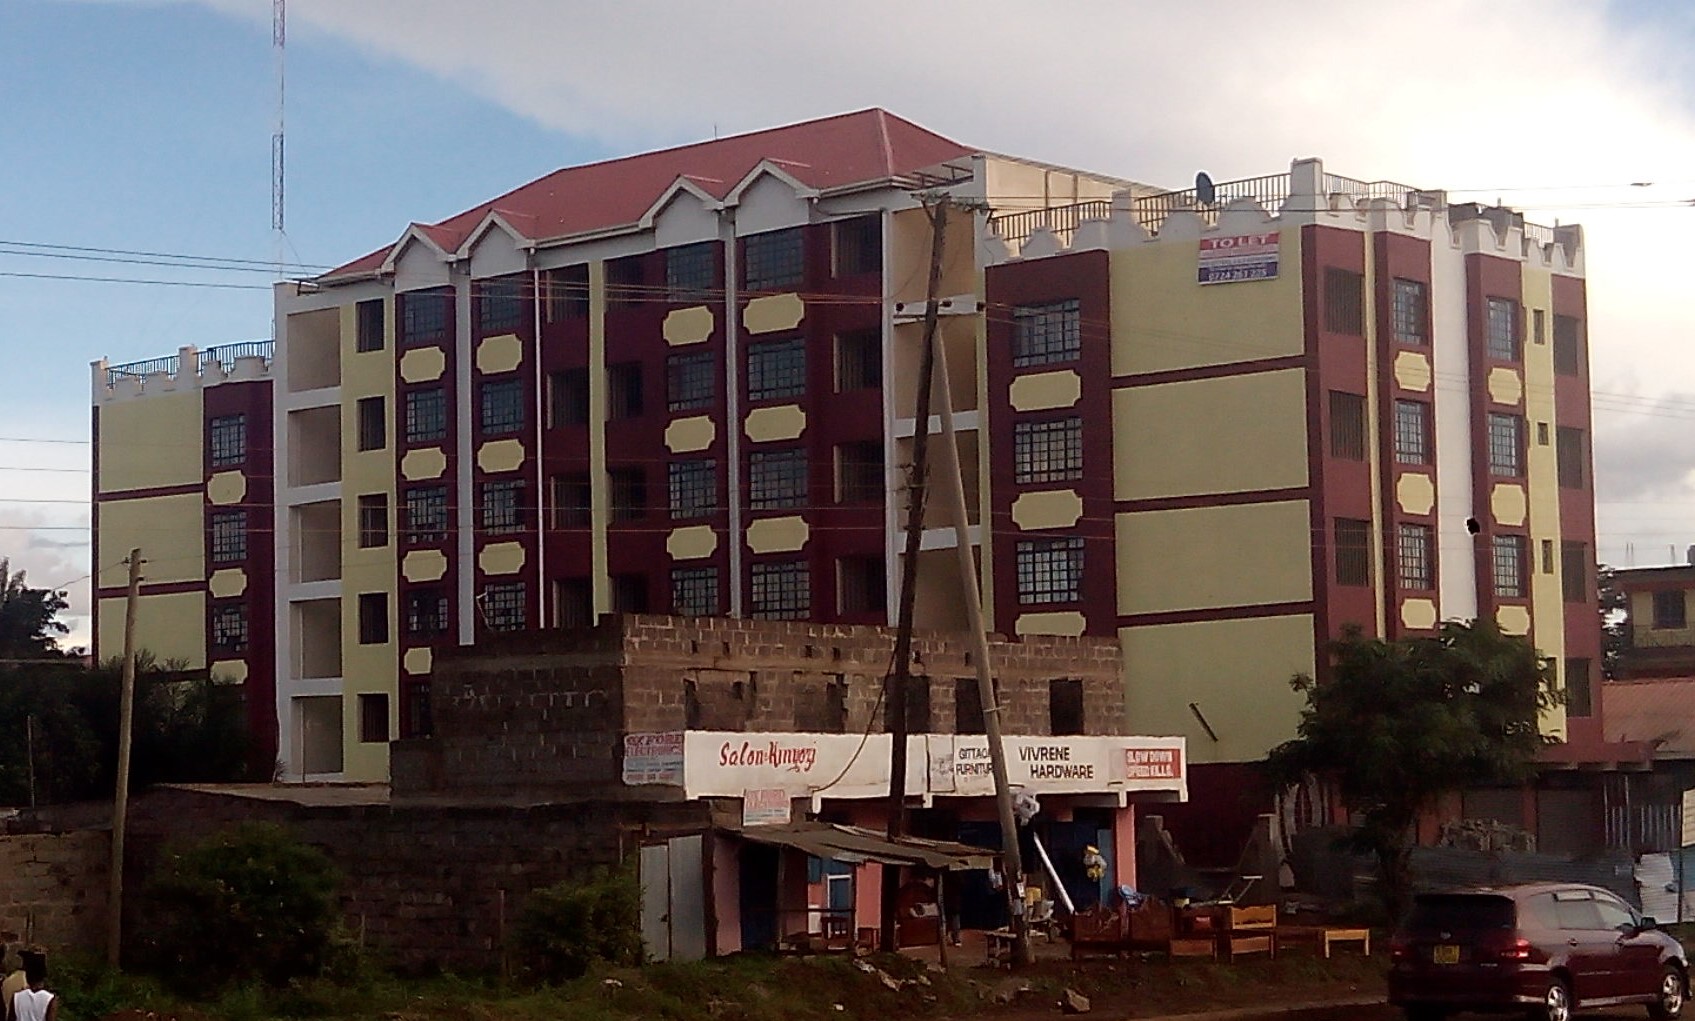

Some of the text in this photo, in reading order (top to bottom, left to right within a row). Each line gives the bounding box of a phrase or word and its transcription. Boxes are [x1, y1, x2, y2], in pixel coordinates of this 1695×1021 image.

[1211, 235, 1269, 249] TO LET
[1019, 746, 1070, 761] VIVRENE
[1030, 764, 1094, 779] HARDWARE
